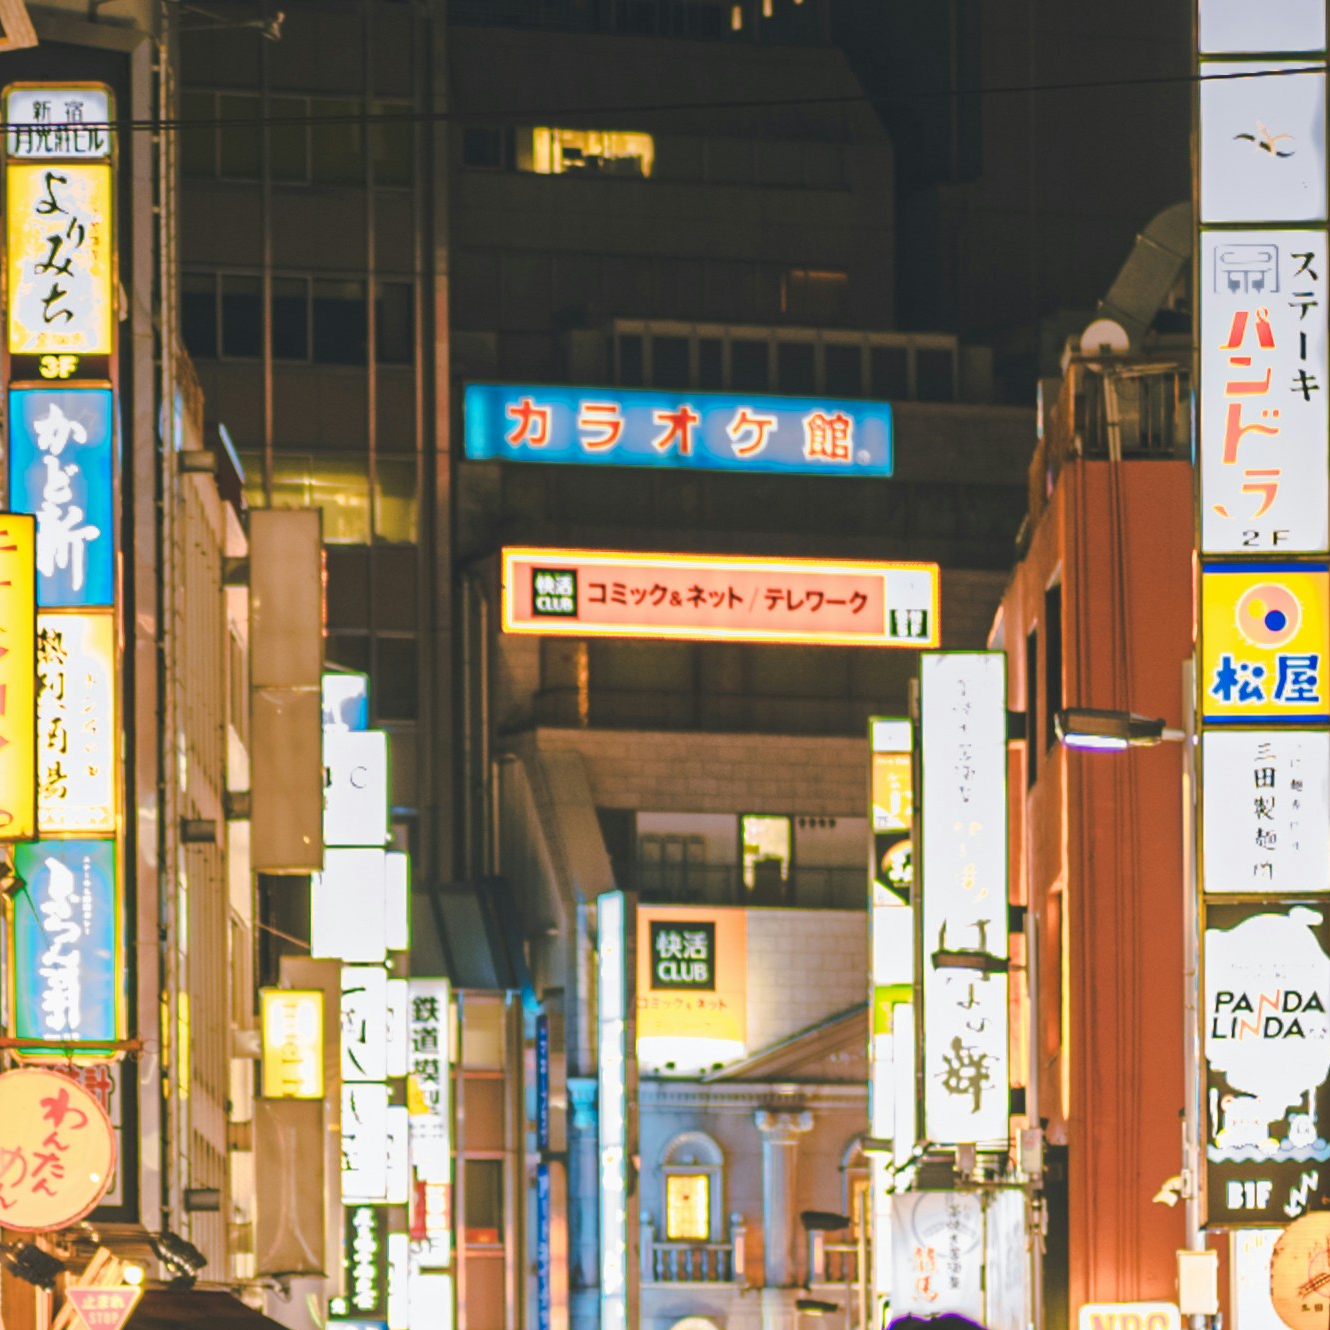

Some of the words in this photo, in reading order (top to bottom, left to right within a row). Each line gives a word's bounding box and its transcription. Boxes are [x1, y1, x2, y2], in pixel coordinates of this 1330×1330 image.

[32, 100, 85, 123] 新宿
[36, 171, 86, 324] よりみち
[1287, 251, 1320, 402] ステーキ
[39, 355, 79, 379] 3F
[1212, 306, 1281, 520] パンドラ
[507, 399, 853, 462] カラオケ館
[1241, 530, 1290, 547] 2F
[1212, 654, 1319, 706] 松屋
[655, 929, 708, 960] 快活
[657, 960, 709, 982] CLUB
[1214, 988, 1326, 1014] PANDA
[1211, 1016, 1306, 1040] LINDA
[30, 1087, 89, 1198] わんたん
[1227, 1179, 1273, 1210] B1F
[82, 1295, 126, 1311] 止まれ
[88, 1311, 119, 1325] STOP
